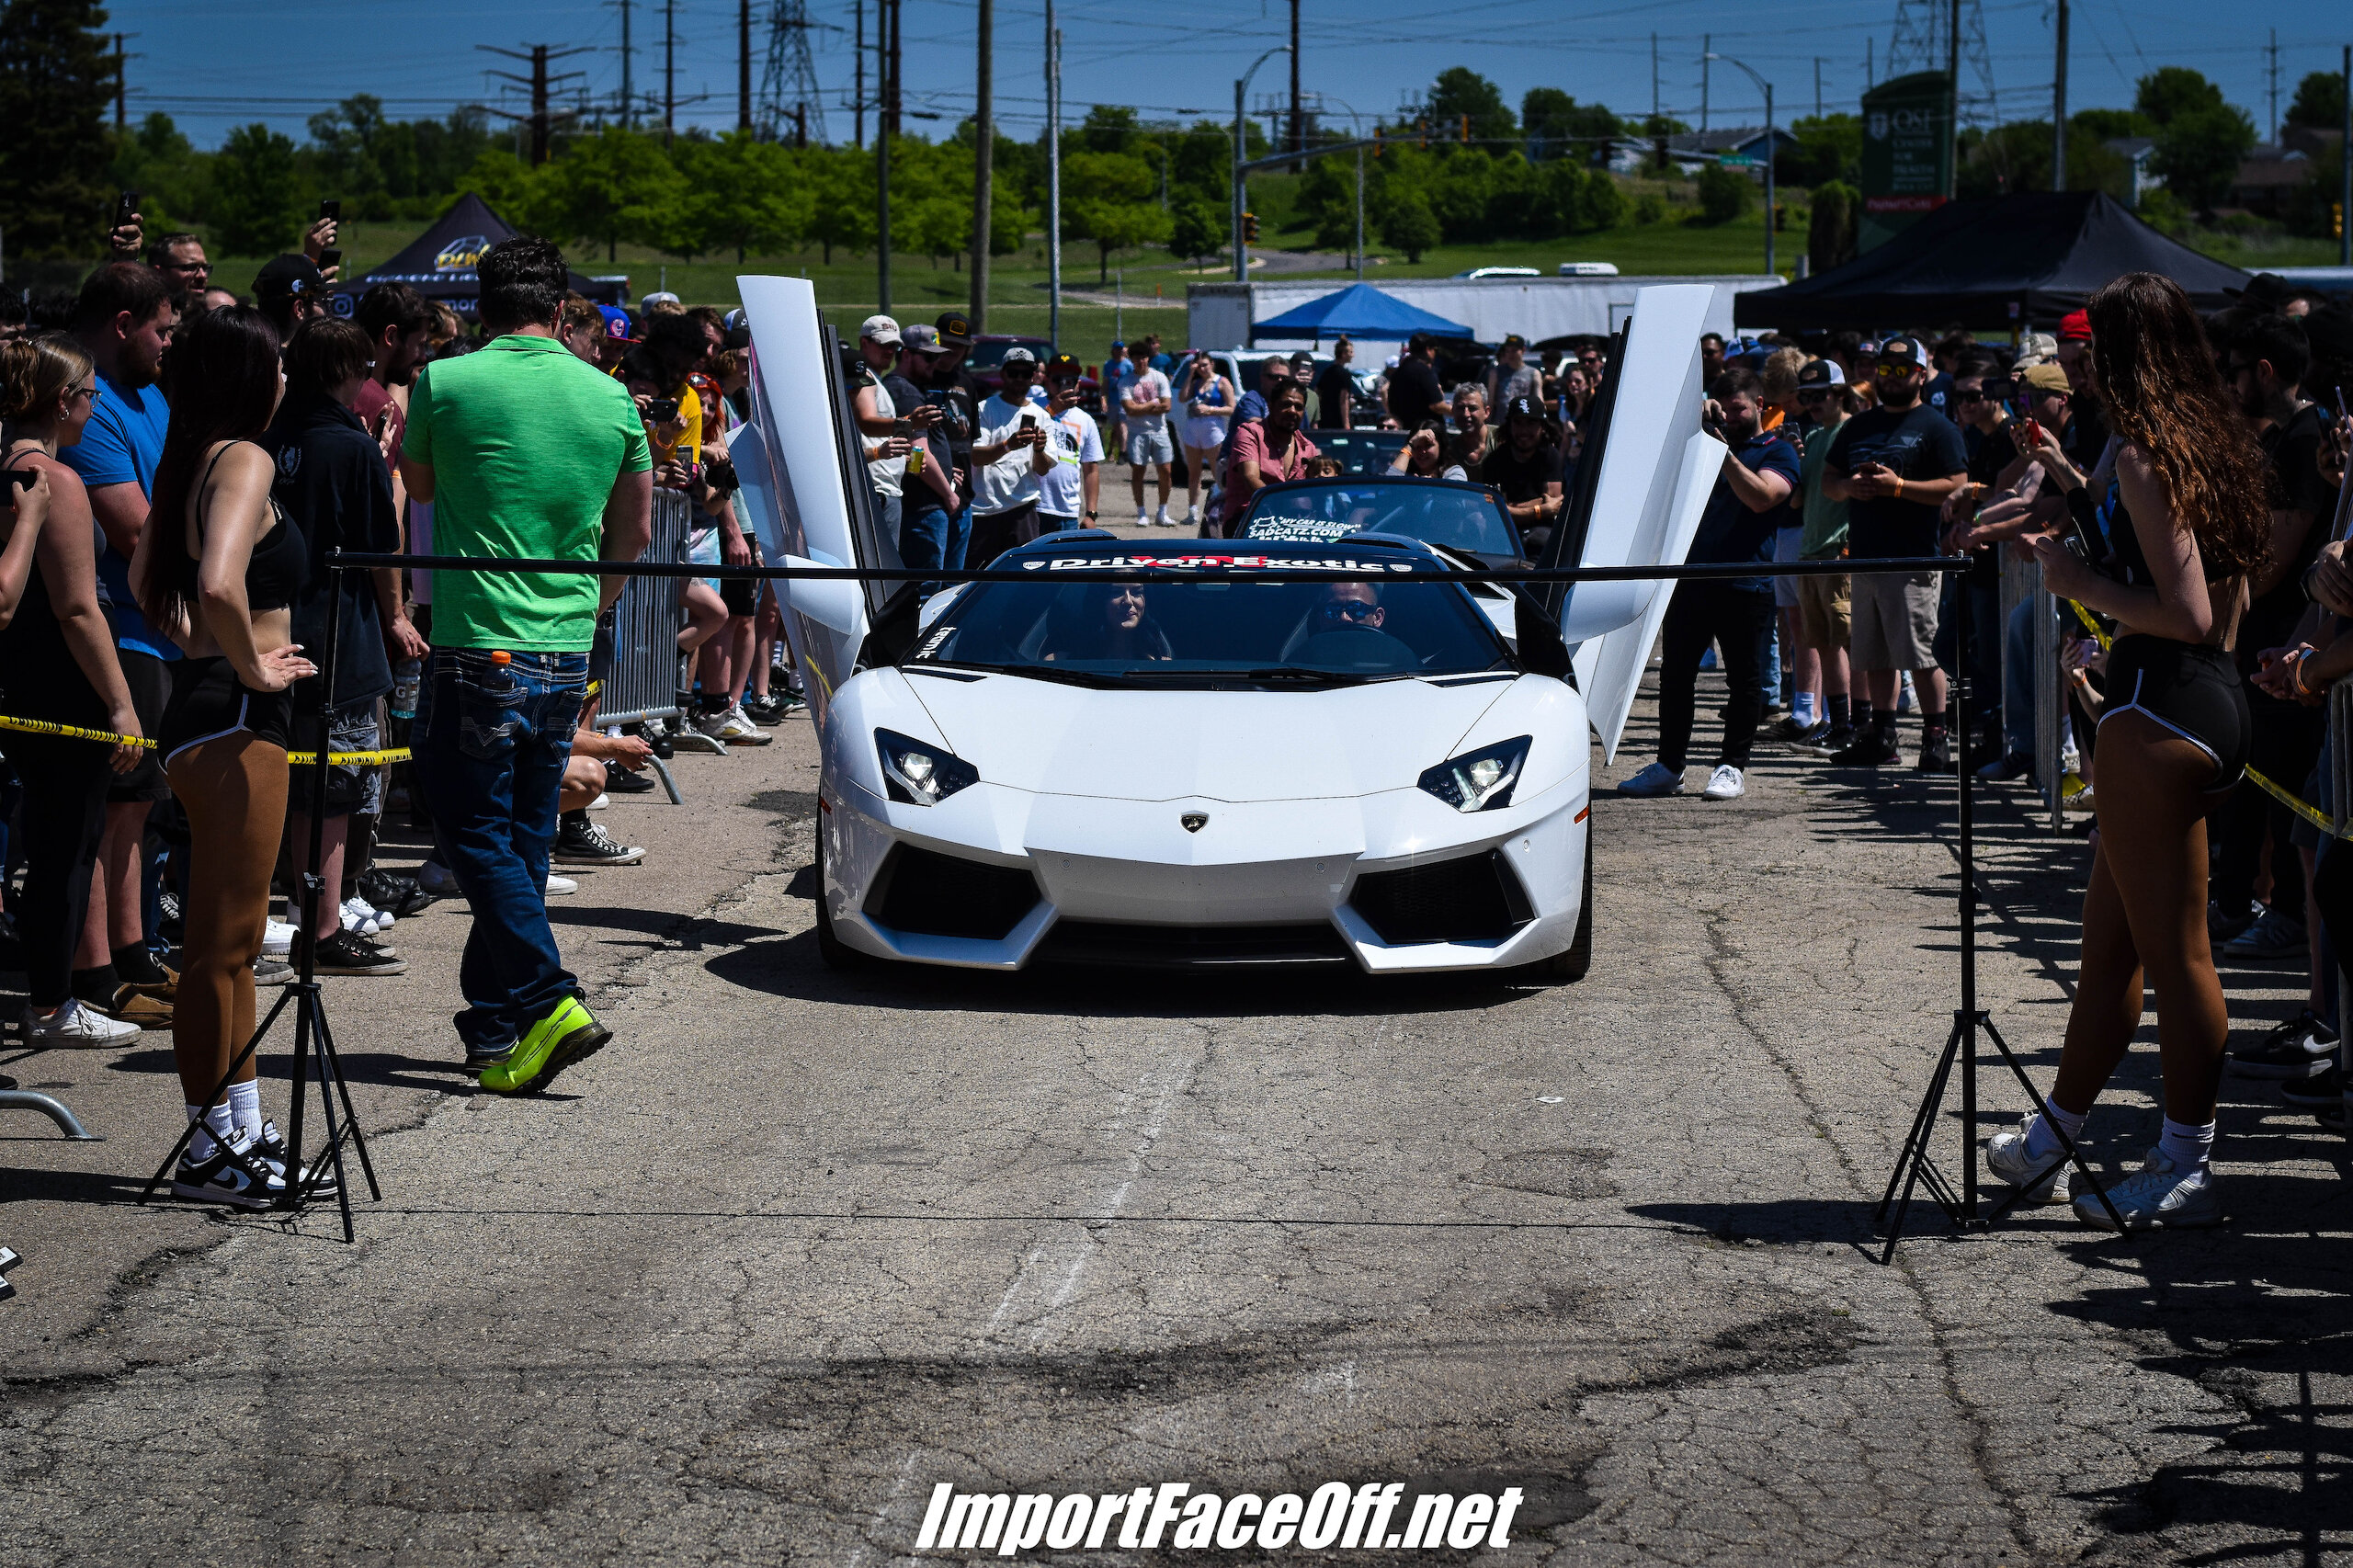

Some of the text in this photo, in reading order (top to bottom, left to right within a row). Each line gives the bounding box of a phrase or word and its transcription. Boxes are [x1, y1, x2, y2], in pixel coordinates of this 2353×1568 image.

[1248, 527, 1344, 539] SADCATZ.COM
[1050, 556, 1221, 570] Driven
[1233, 556, 1384, 572] Exotic
